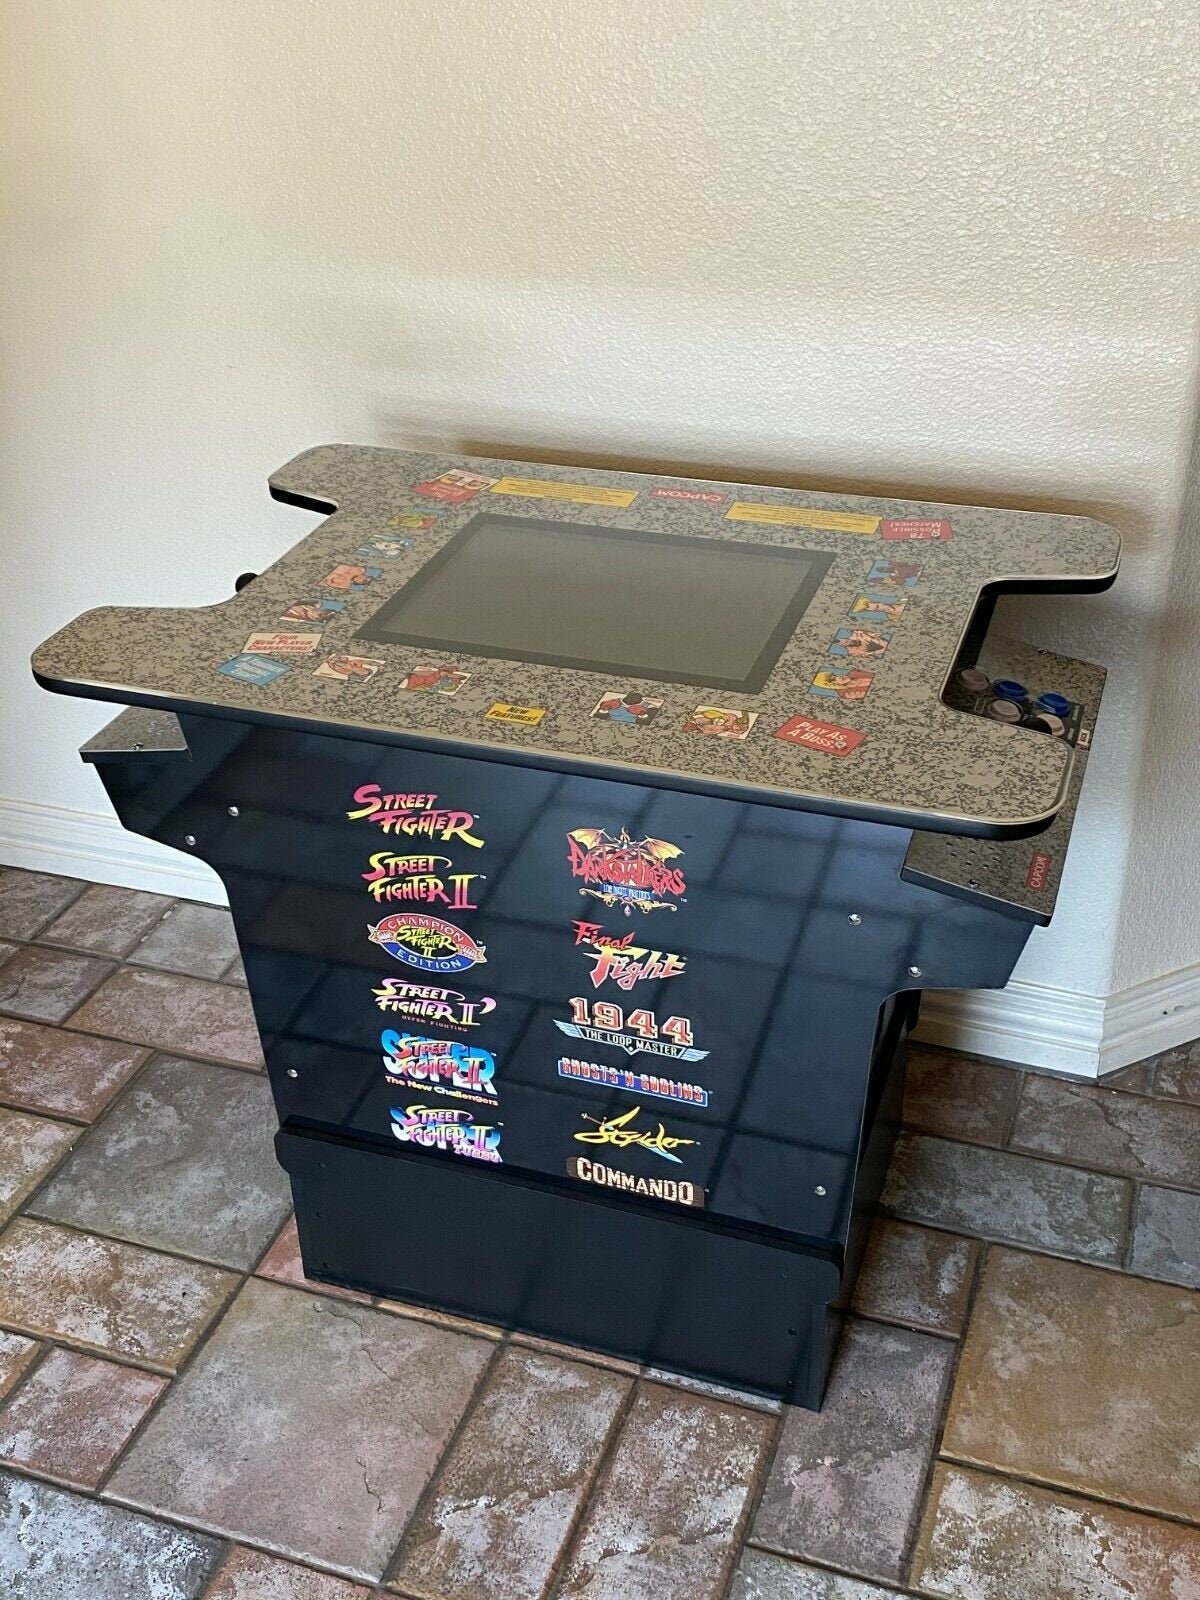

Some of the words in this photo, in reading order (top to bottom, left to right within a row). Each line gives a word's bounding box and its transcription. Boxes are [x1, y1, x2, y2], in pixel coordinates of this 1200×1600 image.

[658, 489, 722, 501] CAPCOM
[505, 706, 529, 714] NEW
[786, 729, 801, 737] A
[795, 721, 830, 735] PLAY
[825, 731, 848, 741] AS
[346, 784, 438, 820] STREET
[368, 810, 485, 848] FIGHTER
[361, 851, 453, 881] STREET
[1030, 856, 1048, 888] CAPCOM
[367, 874, 451, 903] FIGHTER
[448, 874, 479, 909] II
[388, 917, 464, 942] CHAMPION
[396, 924, 436, 941] STREET
[405, 934, 457, 951] FIGHTER
[396, 948, 461, 969] EDITION
[582, 938, 686, 991] Fight
[371, 978, 466, 1001] STREET
[375, 995, 459, 1024] FIGHTER
[569, 997, 694, 1047] 1944
[395, 1037, 467, 1059] STREET
[584, 1027, 603, 1041] THE
[606, 1033, 632, 1047] LOOP
[635, 1039, 678, 1057] MASTER
[385, 1075, 406, 1087] The
[407, 1078, 432, 1092] New
[433, 1085, 499, 1106] Challengers
[403, 1105, 474, 1127] STREET
[576, 1156, 694, 1206] COMMANDO
